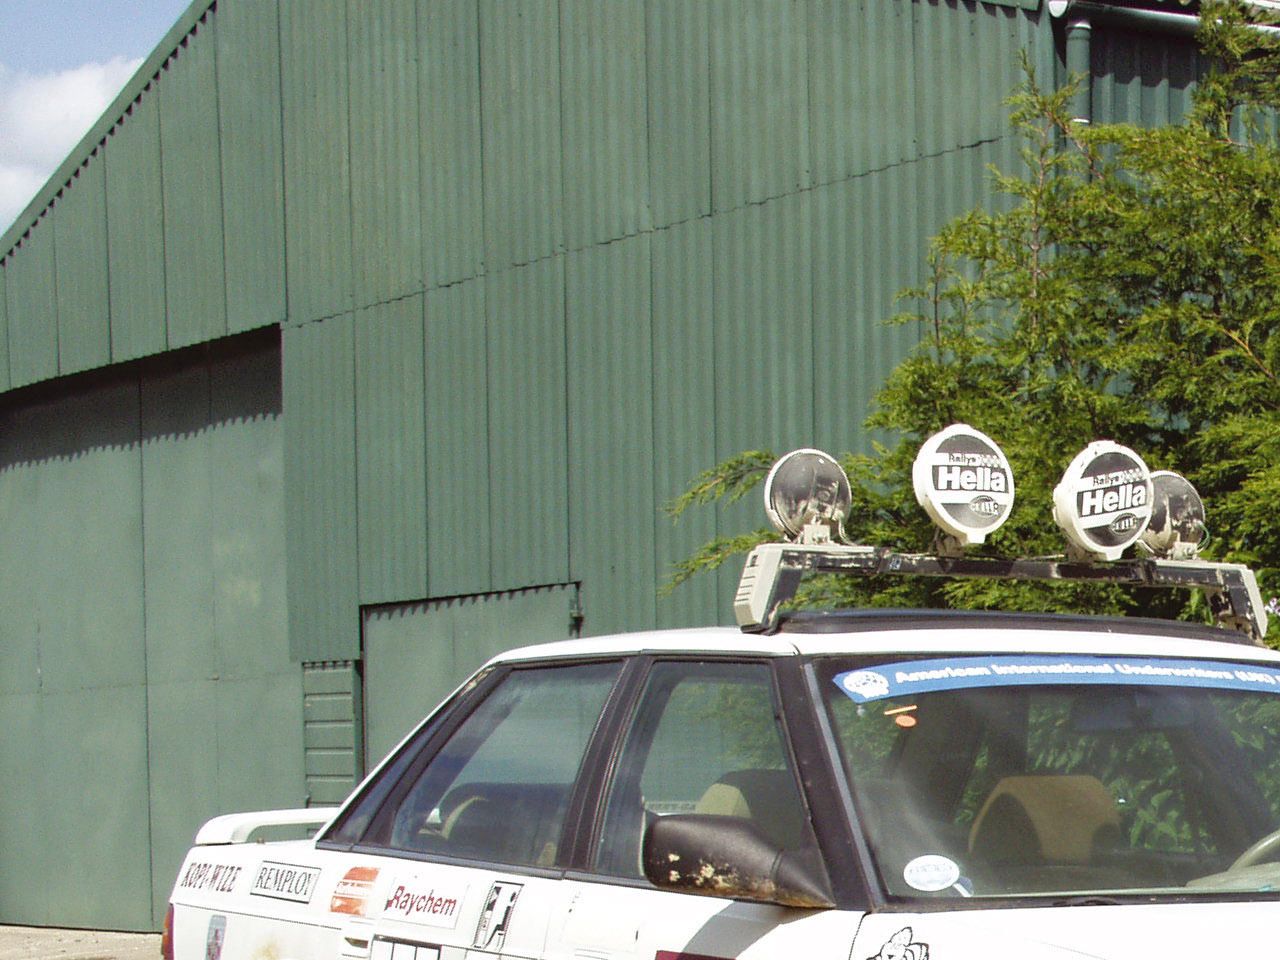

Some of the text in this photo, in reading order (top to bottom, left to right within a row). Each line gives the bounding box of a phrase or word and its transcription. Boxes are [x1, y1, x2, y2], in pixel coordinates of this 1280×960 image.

[938, 466, 1006, 492] Hella
[1081, 483, 1146, 516] Hella
[391, 885, 456, 916] Raychem
